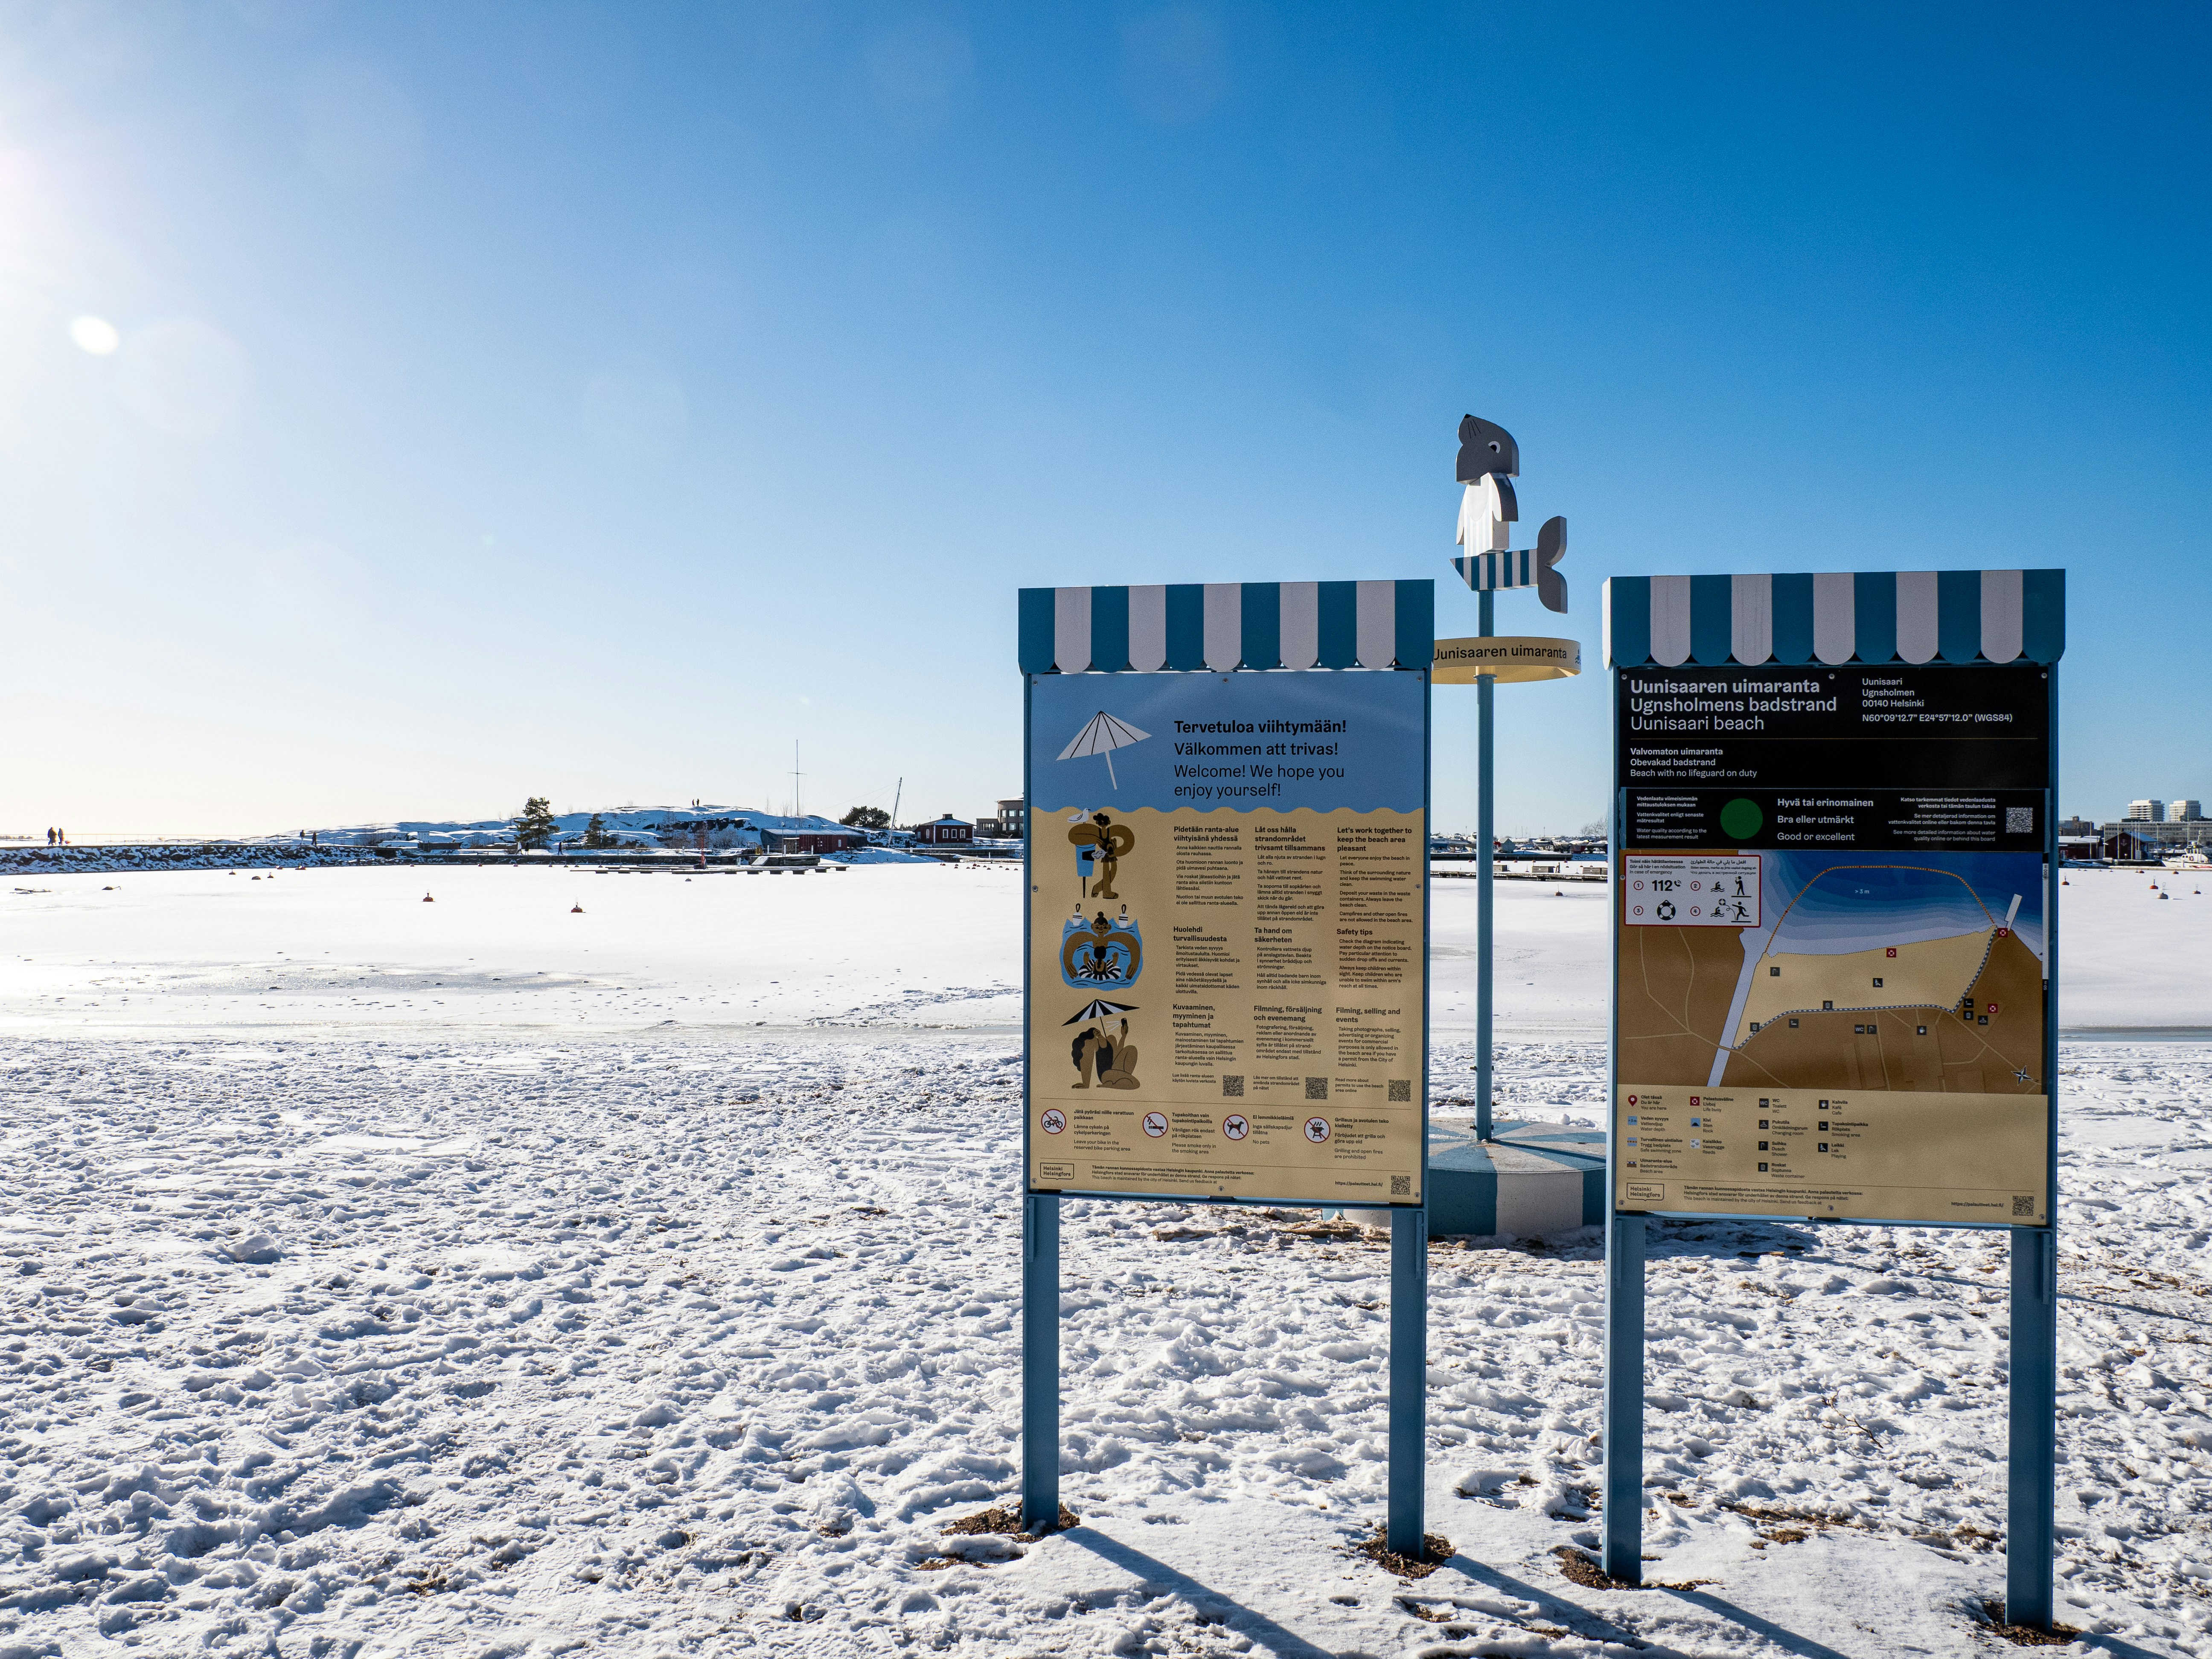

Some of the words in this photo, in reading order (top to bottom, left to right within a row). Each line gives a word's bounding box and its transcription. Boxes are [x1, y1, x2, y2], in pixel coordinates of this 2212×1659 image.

[1511, 645, 1567, 659] uimaranta
[1631, 679, 1727, 693] Uunisaaren
[1732, 678, 1819, 693] uimaranta
[1862, 688, 1915, 698] Ugnsholmen
[1631, 697, 1744, 714] Ugnsholmens
[1749, 696, 1837, 711] badstrand
[1890, 699, 1924, 707] Helsinki
[1974, 713, 2012, 722] (WGS84)
[1174, 719, 1254, 733] Tervetuloa
[1257, 719, 1346, 736] viihtymään!
[1631, 716, 1708, 730] Uunisaari
[1714, 716, 1764, 730] beach
[1174, 742, 1261, 755] Välkommen
[1266, 742, 1286, 755] att
[1289, 742, 1338, 755] trivas!
[1680, 747, 1723, 755] uimaranta
[1630, 758, 1671, 766] Obevakad
[1174, 764, 1246, 777] Welcome!
[1250, 765, 1273, 777] We
[1278, 764, 1314, 781] hope
[1318, 768, 1344, 781] you
[1688, 768, 1724, 778] lifeguard
[1739, 769, 1757, 778] duty
[1174, 783, 1213, 799] enjoy
[1216, 783, 1281, 800] yourself!
[1777, 798, 1800, 807] Hyvä
[1777, 815, 1793, 823] Bra
[1796, 815, 1816, 824] eller
[1818, 815, 1854, 824] utmärkt
[1374, 827, 1404, 835] together
[1173, 835, 1209, 843] viihtyisänä
[1210, 835, 1238, 843] yhdessä
[1337, 835, 1353, 844] keep
[1777, 832, 1801, 840] Good
[1815, 832, 1855, 841] excellent
[1337, 844, 1366, 853] pleasant
[1652, 880, 1673, 891] 112
[1336, 928, 1359, 936] Safety
[1359, 928, 1373, 937] tips
[1254, 1005, 1284, 1013] Filmning,
[1285, 1005, 1322, 1014] försäljning
[1336, 1007, 1363, 1015] Filming,
[1364, 1007, 1386, 1016] selling
